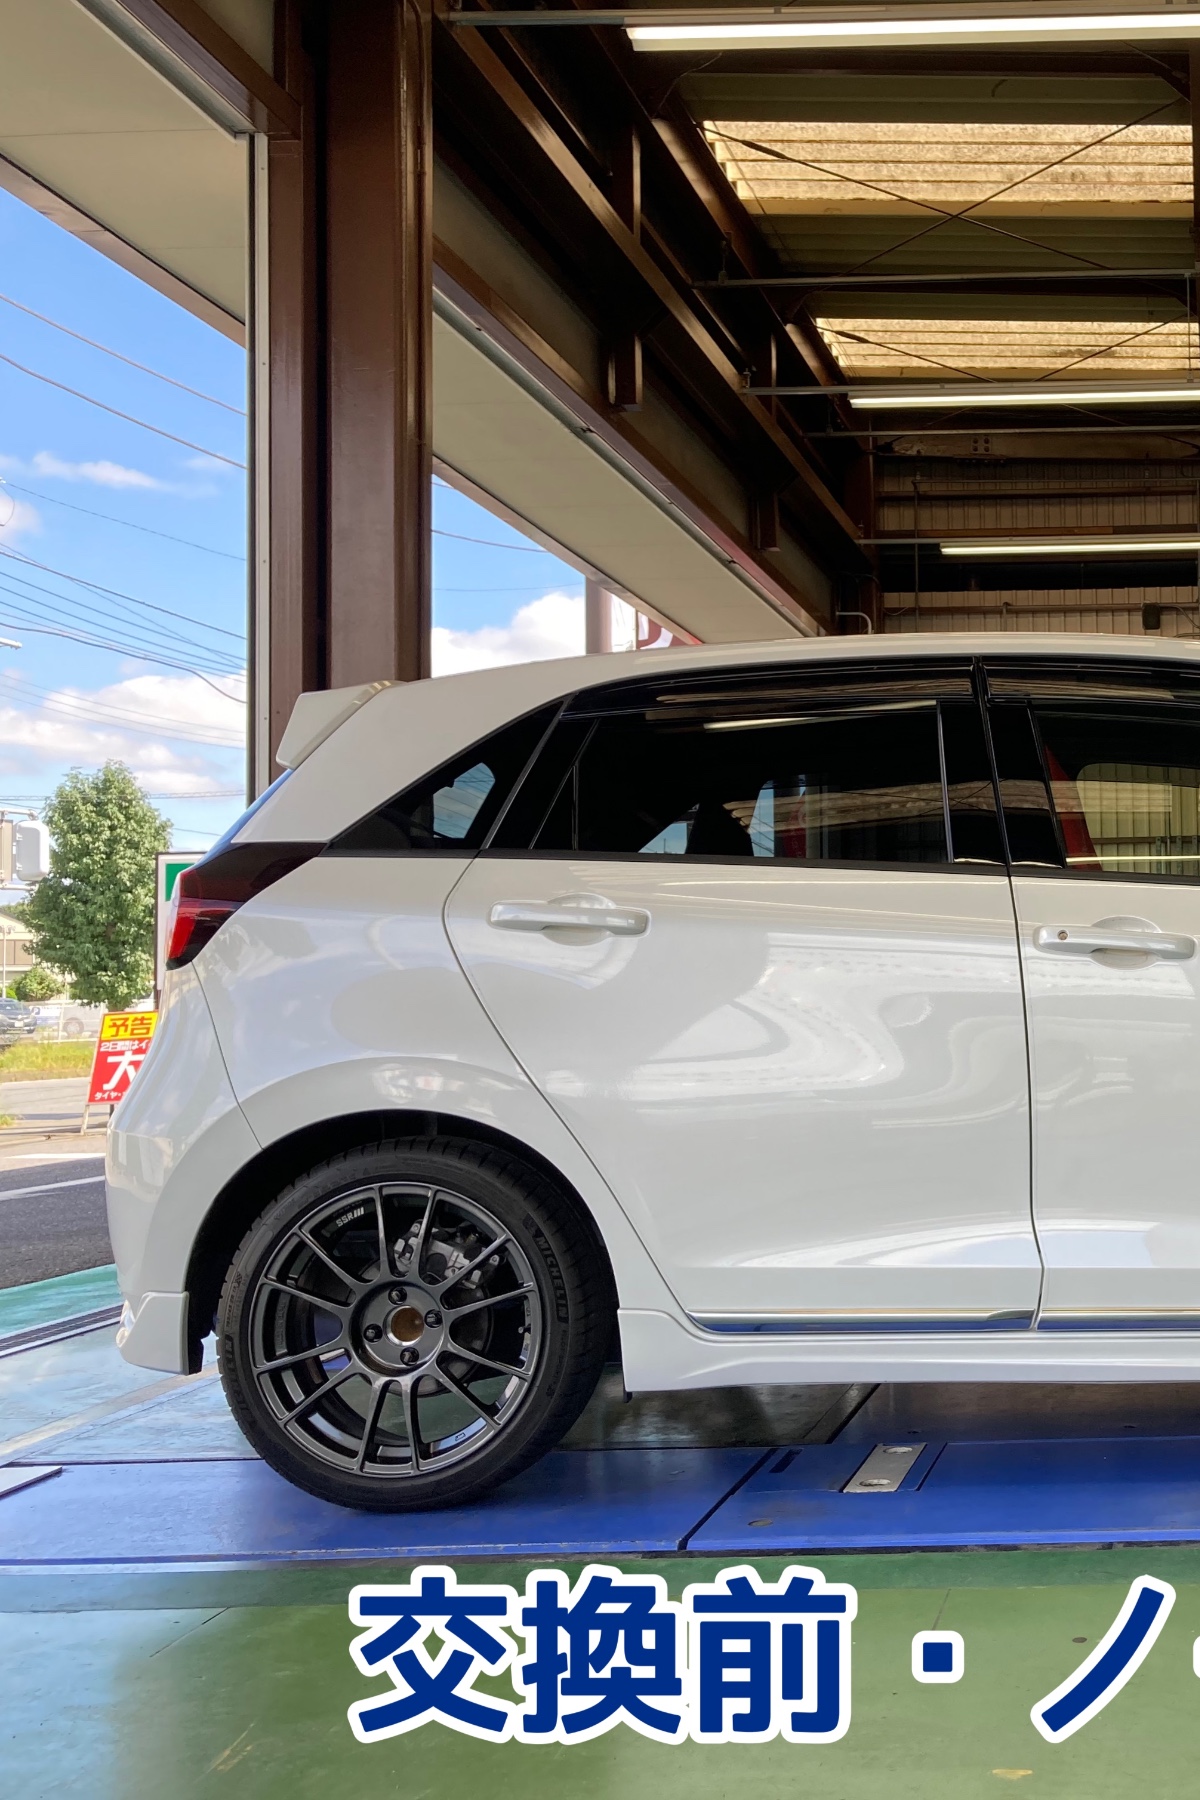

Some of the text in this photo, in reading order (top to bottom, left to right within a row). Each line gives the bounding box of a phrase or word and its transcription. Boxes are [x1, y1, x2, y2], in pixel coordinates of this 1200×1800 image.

[109, 1016, 152, 1037] 予告
[100, 1040, 151, 1052] 2日間はイ
[102, 1050, 146, 1090] 大
[95, 1091, 126, 1101] タイヤ・
[536, 1235, 569, 1321] MICHELIN
